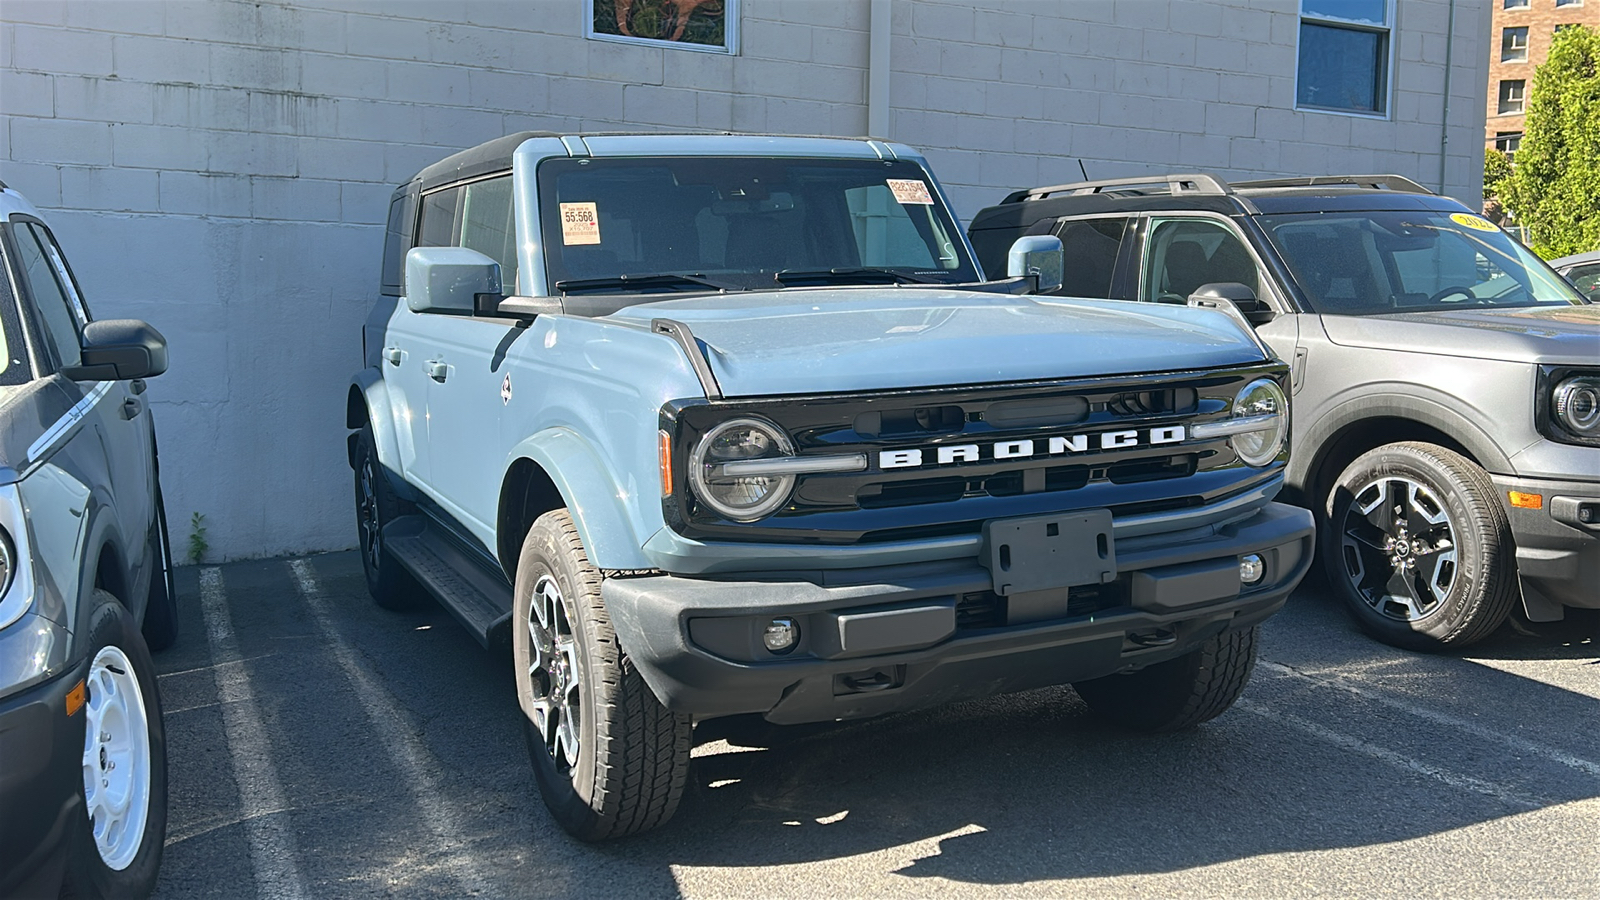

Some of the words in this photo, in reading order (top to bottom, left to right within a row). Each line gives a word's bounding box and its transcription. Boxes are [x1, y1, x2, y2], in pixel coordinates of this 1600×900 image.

[565, 211, 594, 223] 55:568
[879, 425, 1186, 469] BRONCO
[1455, 582, 1471, 614] PRIMACY
